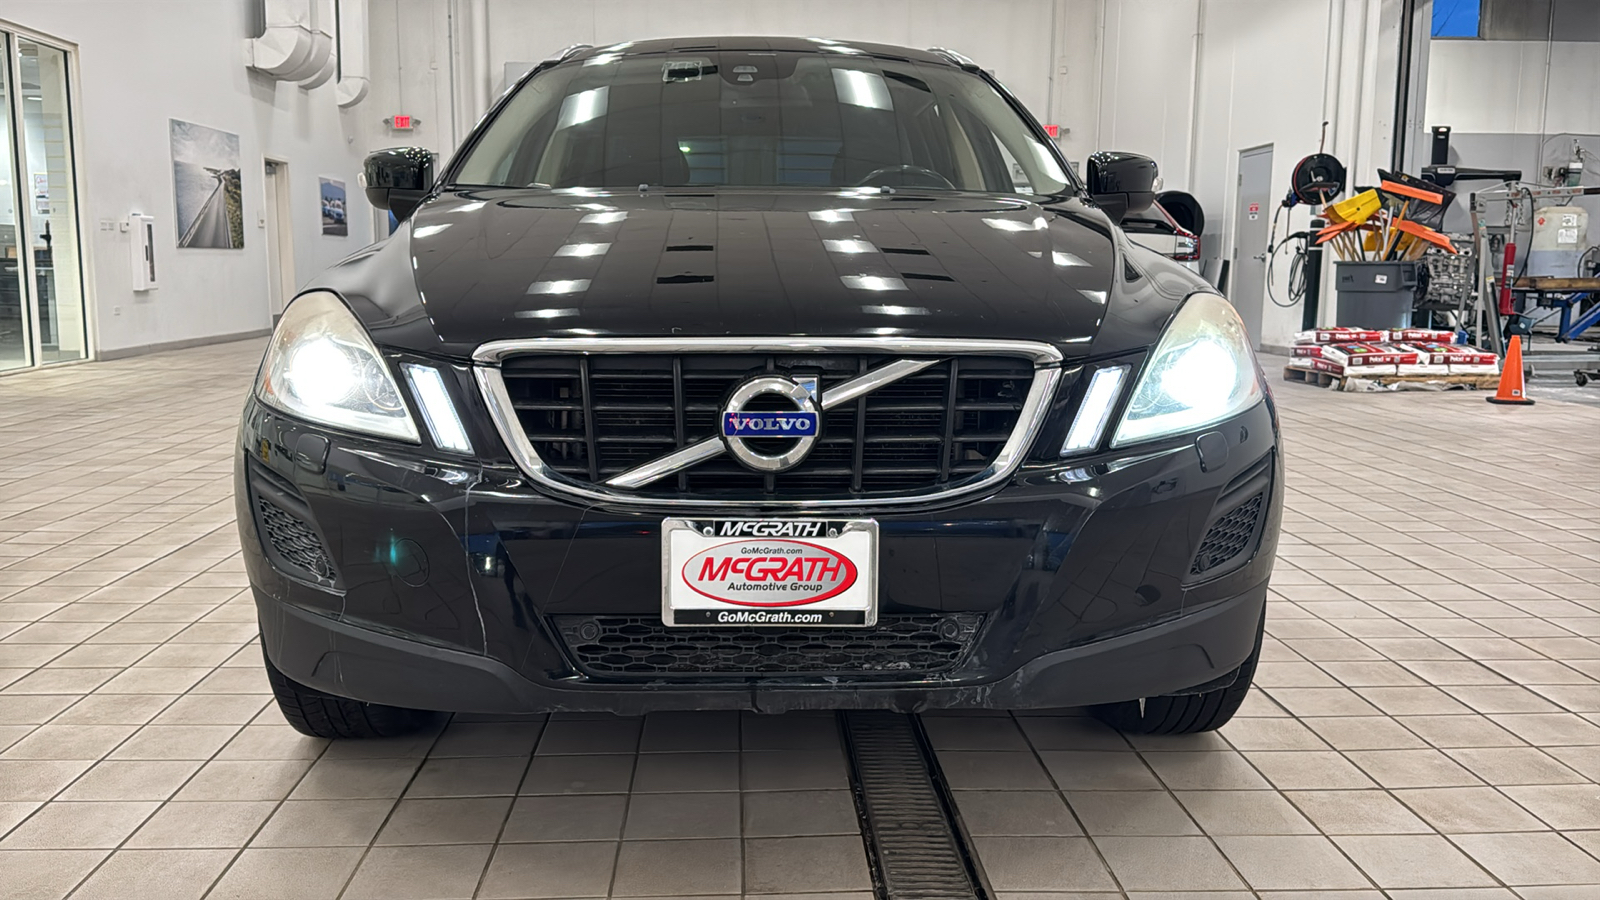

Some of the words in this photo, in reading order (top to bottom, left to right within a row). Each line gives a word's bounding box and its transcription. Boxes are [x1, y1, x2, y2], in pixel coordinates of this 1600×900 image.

[728, 417, 811, 431] VOLVO
[740, 547, 803, 555] GoMcGrath.com
[727, 582, 788, 591] Automotive
[790, 582, 823, 593] Group
[717, 611, 823, 623] GoMcGrath.com
